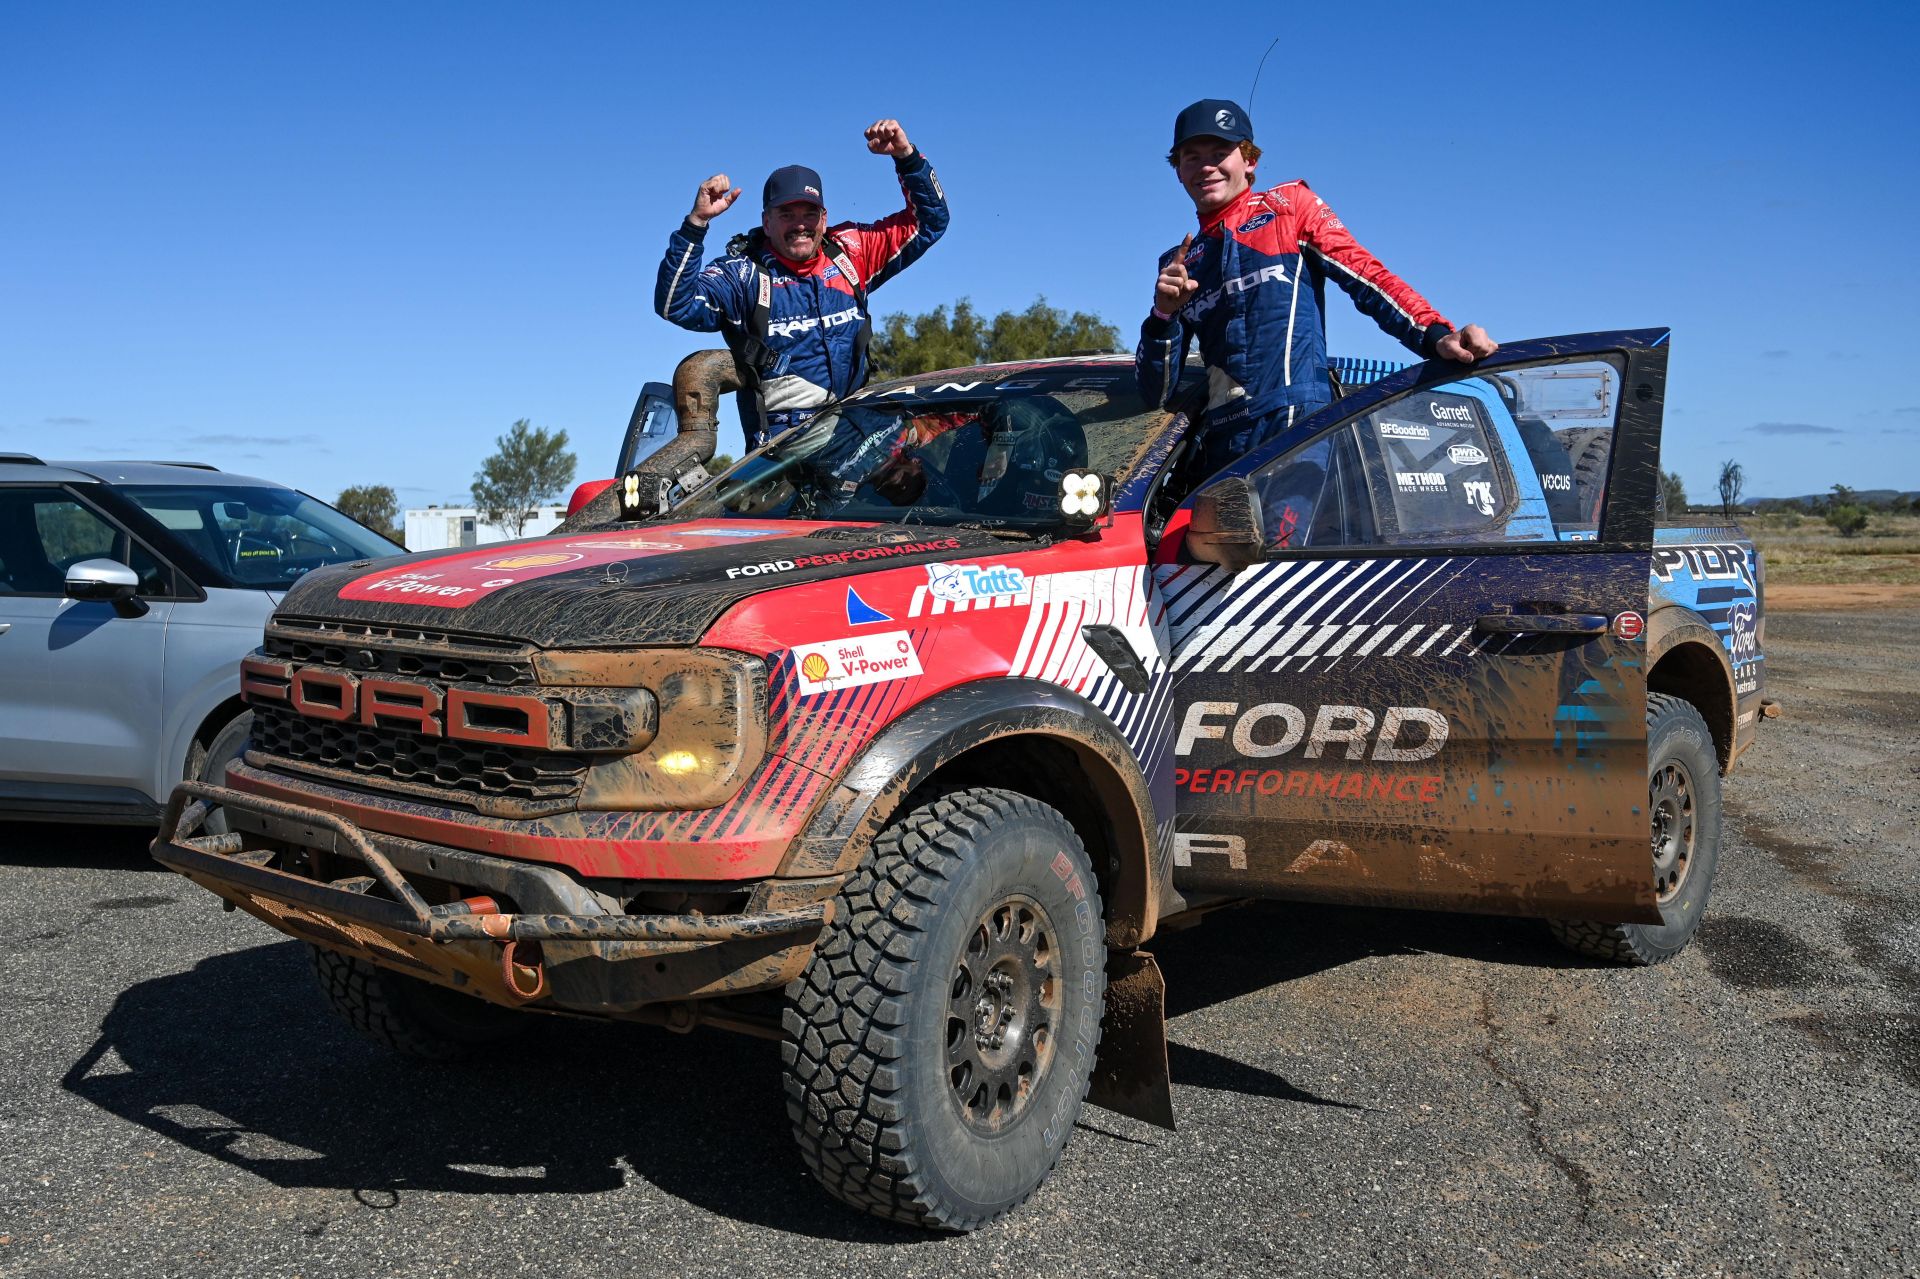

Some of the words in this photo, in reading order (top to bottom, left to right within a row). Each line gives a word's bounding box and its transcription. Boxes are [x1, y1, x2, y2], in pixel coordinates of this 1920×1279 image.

[1245, 213, 1268, 232] Ford
[1184, 242, 1206, 263] ORD
[1182, 264, 1293, 323] RAPTOR
[767, 306, 866, 339] RAPTOR
[799, 412, 817, 421] Bra
[1430, 401, 1472, 421] Garrett
[1380, 422, 1430, 437] BFGoodrich
[1451, 447, 1478, 464] PWR
[1396, 472, 1446, 486] METHOD
[1542, 473, 1571, 491] VOCUS
[1399, 485, 1418, 493] RACE
[366, 579, 478, 598] V-Power
[962, 568, 1024, 596] Tatts
[1620, 616, 1637, 636] E
[838, 645, 865, 661] Shell
[841, 655, 909, 677] V-Power
[1734, 663, 1757, 680] EARS
[240, 660, 549, 748] FORD
[1174, 701, 1449, 762] FORD
[1174, 768, 1442, 802] PERFORMANCE
